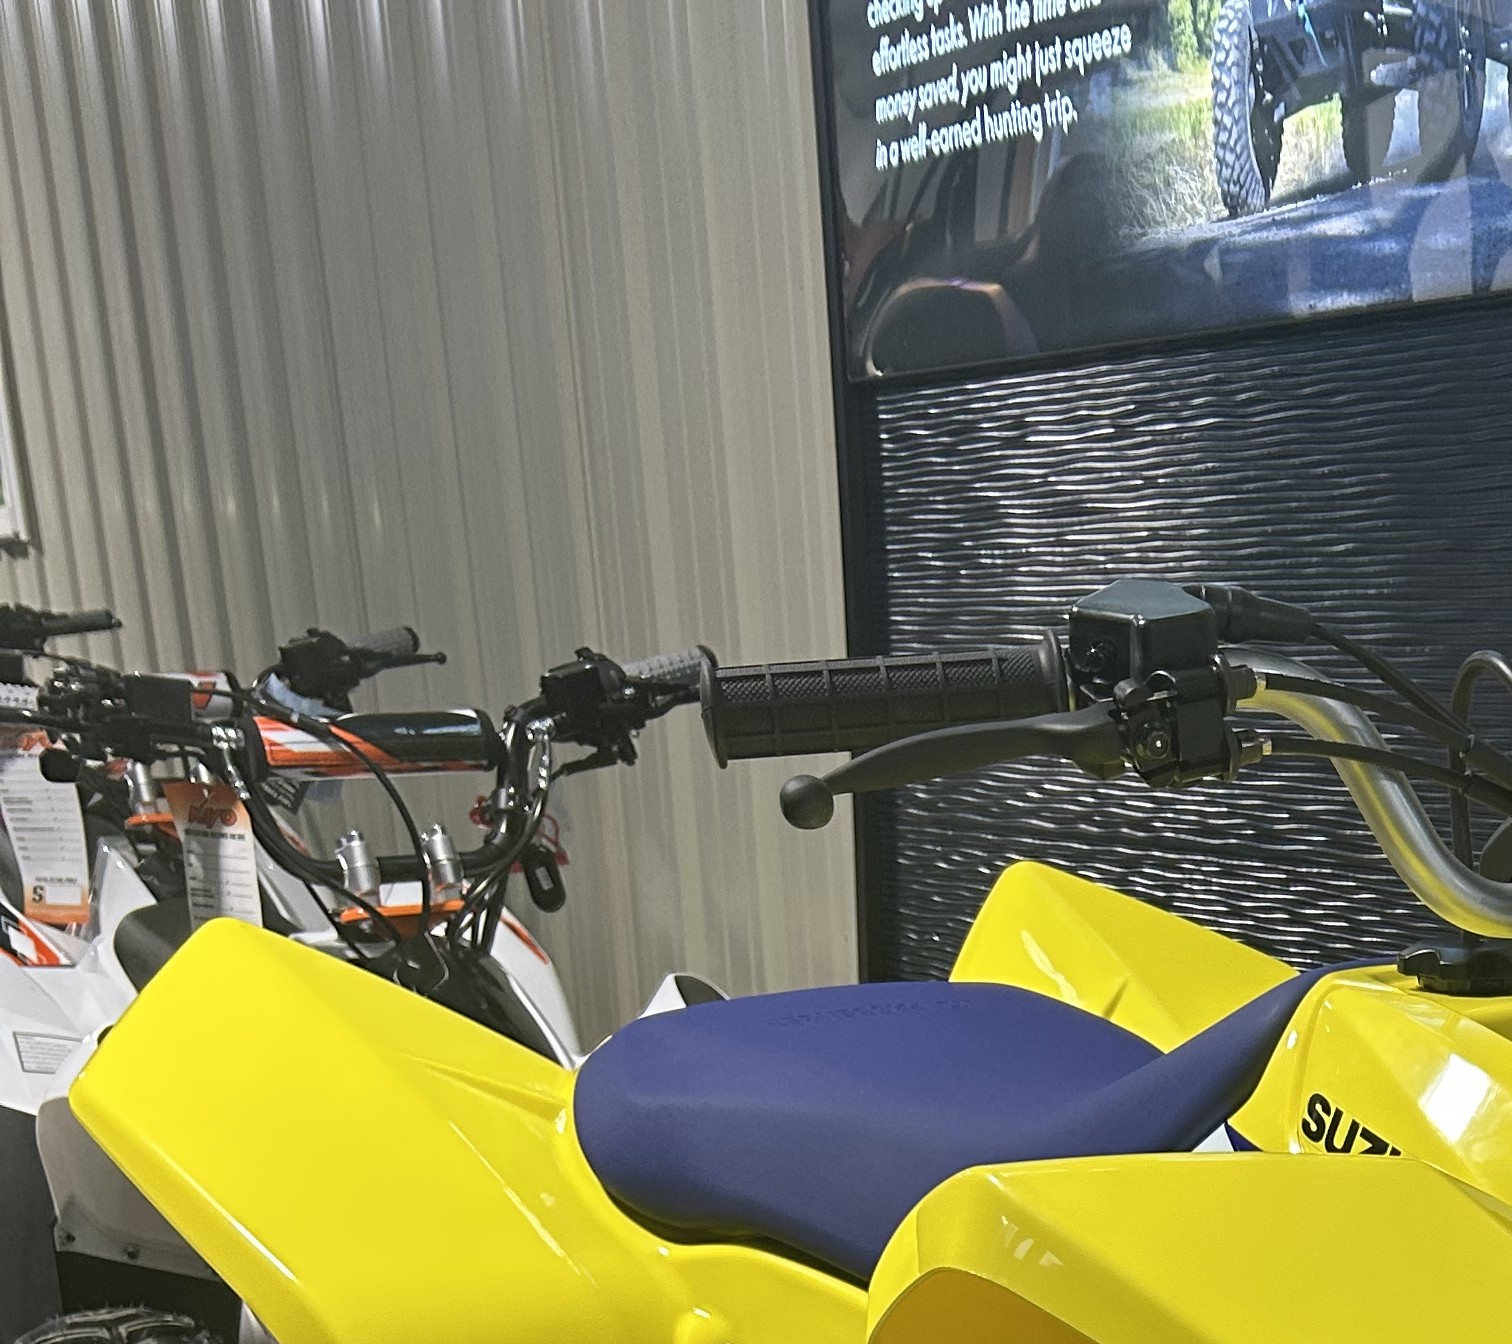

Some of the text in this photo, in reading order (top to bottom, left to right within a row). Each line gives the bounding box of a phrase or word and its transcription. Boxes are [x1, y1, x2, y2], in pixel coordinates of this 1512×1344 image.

[872, 27, 931, 77] effortless
[930, 12, 969, 57] tasks.
[967, 0, 1003, 43] With
[1005, 0, 1031, 32] the
[875, 87, 917, 124] money
[961, 65, 989, 108] you
[990, 42, 1033, 96] might
[1034, 36, 1062, 88] just
[1064, 23, 1132, 77] squeeze
[875, 88, 1079, 171] in a well-earned hunting trip.
